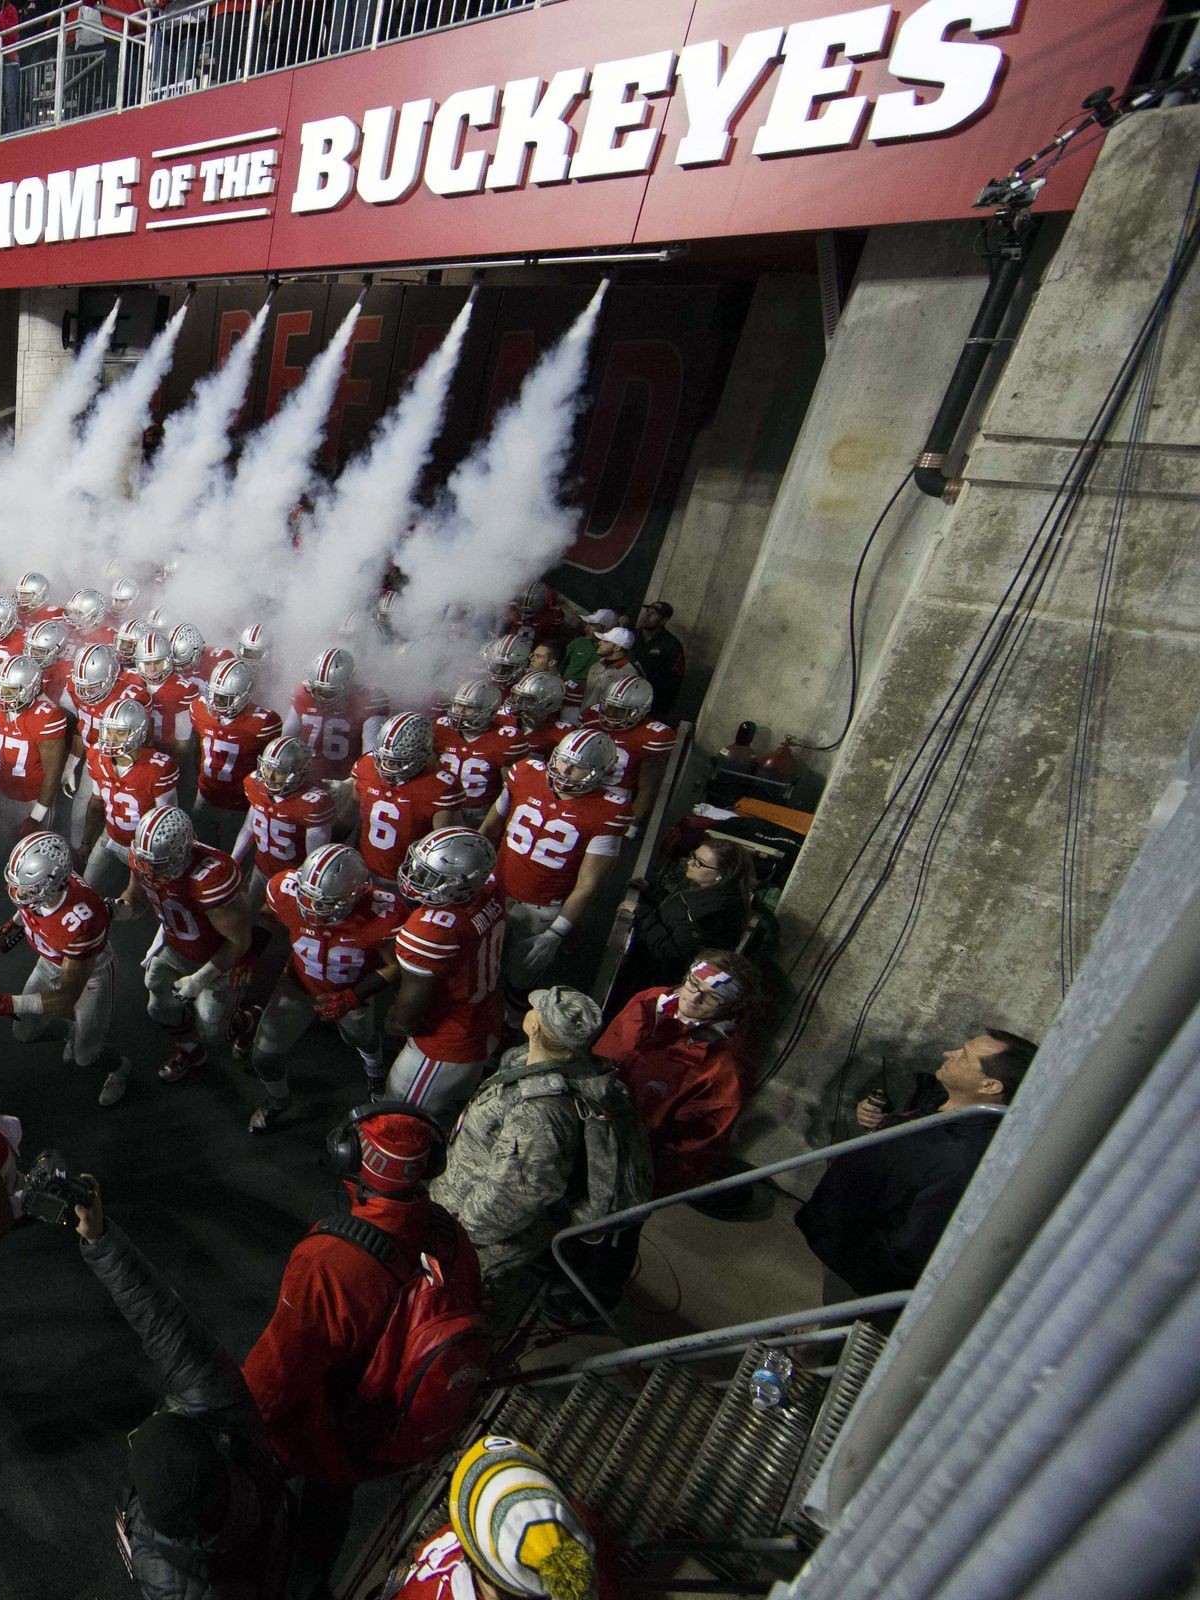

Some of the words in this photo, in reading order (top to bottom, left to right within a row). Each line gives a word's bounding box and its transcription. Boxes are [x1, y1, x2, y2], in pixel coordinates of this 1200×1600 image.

[149, 165, 194, 209] OF
[199, 149, 275, 203] THE
[291, 0, 1018, 214] BUCKEYES
[202, 736, 240, 783] 17
[300, 713, 352, 761] 76
[101, 786, 141, 831] 13
[368, 799, 401, 851] 6
[252, 808, 297, 861] 95
[506, 803, 581, 870] 62
[61, 902, 95, 933] 38
[420, 909, 457, 929] 10
[293, 935, 365, 984] 48
